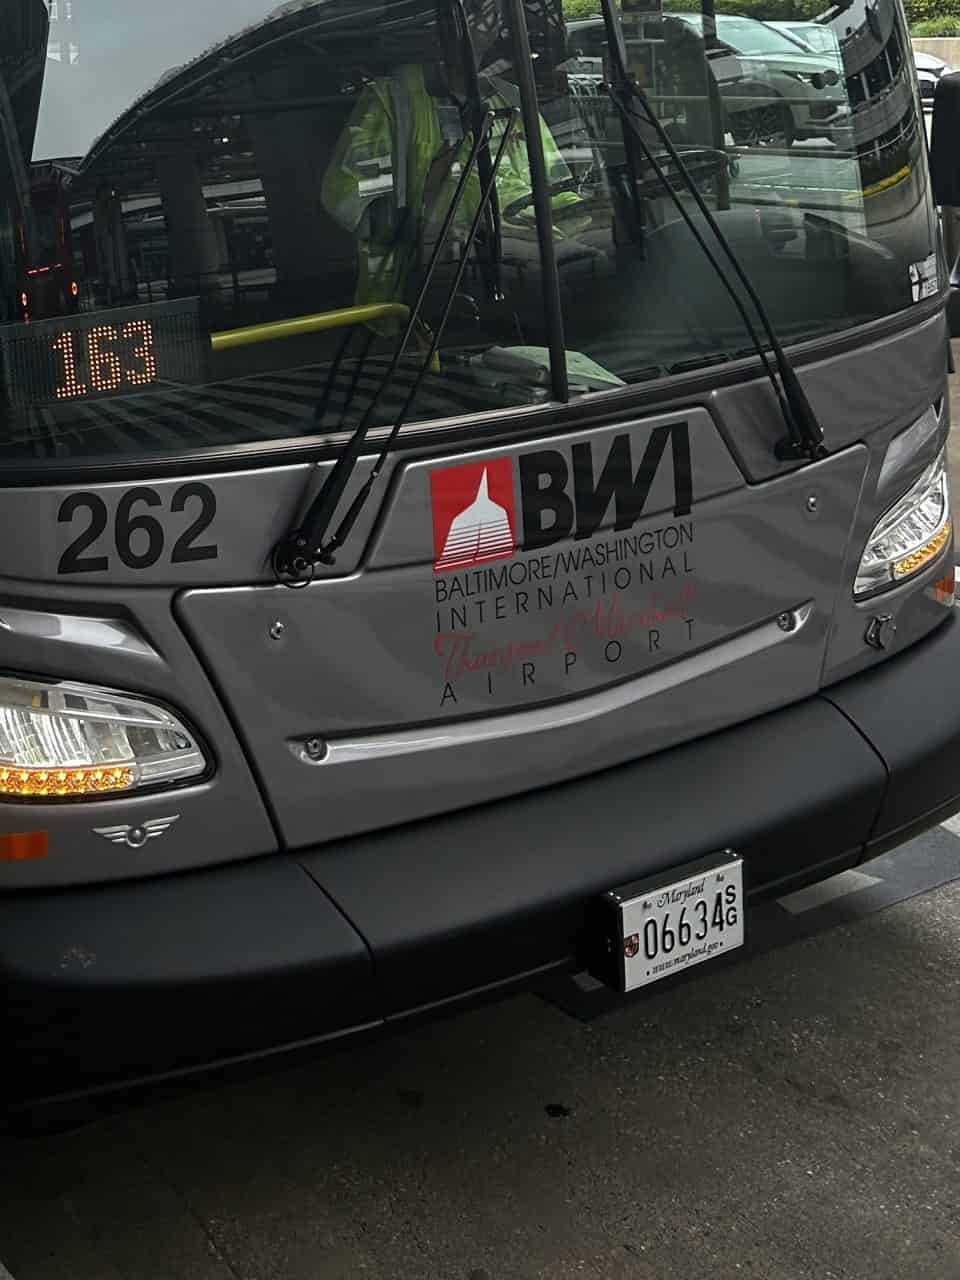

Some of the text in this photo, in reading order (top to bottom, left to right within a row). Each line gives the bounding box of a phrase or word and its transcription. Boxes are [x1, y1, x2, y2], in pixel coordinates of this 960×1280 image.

[52, 320, 156, 398] 163
[518, 421, 694, 552] BWI
[57, 482, 218, 574] 262
[435, 522, 694, 602] BALTIMORE/WASHINGTON
[436, 554, 696, 633] INTERNATIONAL
[440, 619, 695, 707] AIRPORT
[644, 892, 724, 960] 06634
[656, 877, 706, 907] Maryland
